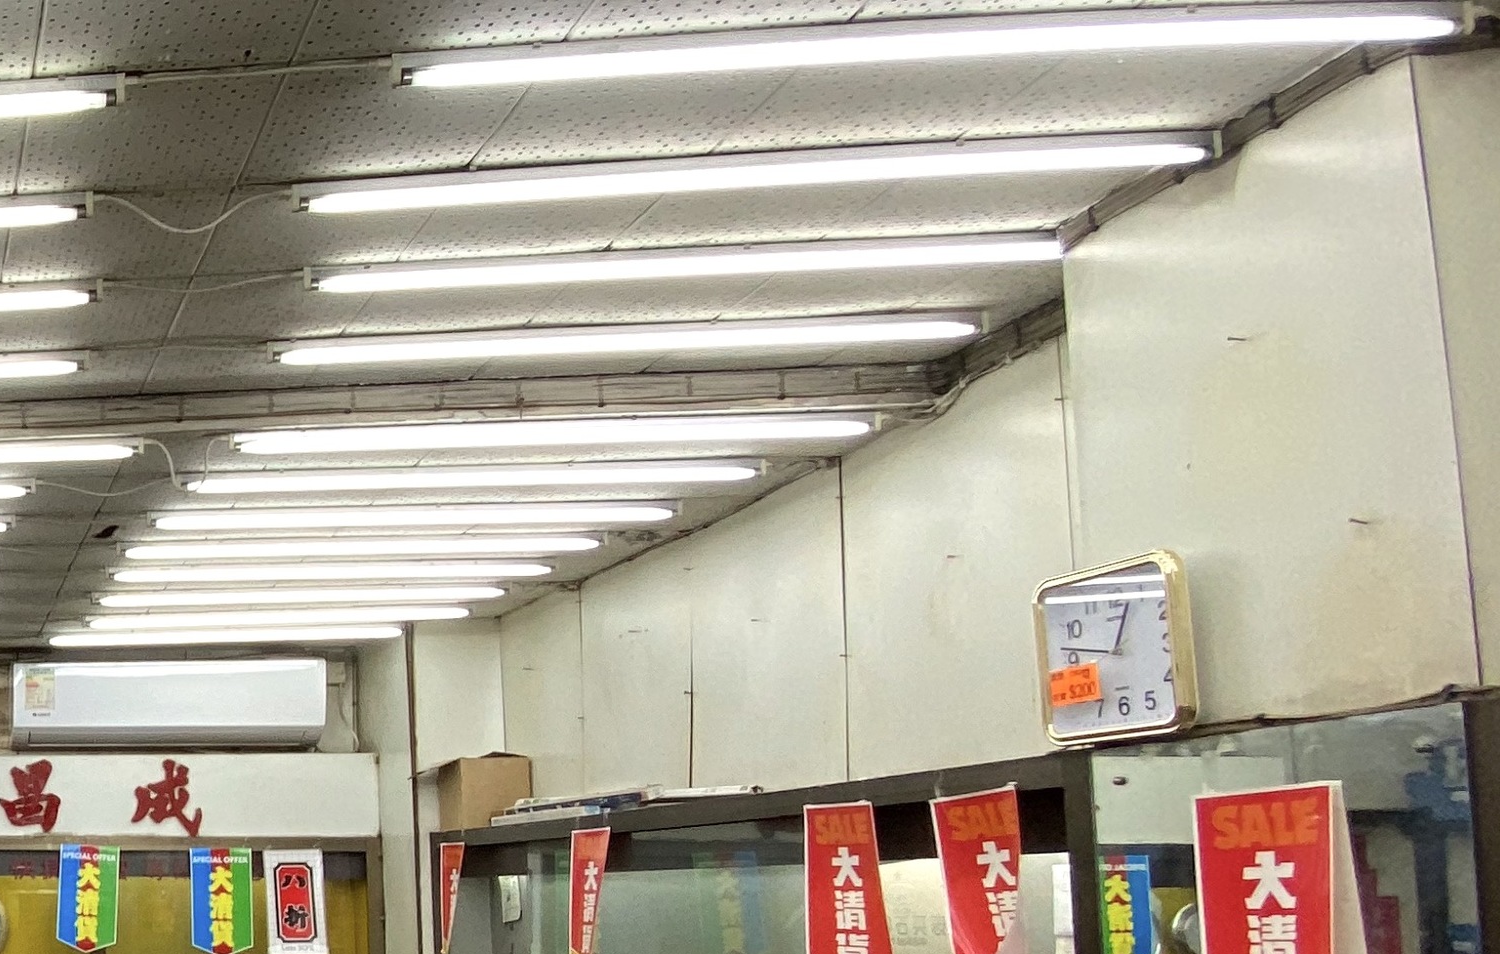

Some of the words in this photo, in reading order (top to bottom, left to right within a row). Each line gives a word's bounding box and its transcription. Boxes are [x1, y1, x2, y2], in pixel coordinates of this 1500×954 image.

[1066, 619, 1082, 640] 10
[1118, 696, 1130, 716] 6
[1144, 690, 1157, 711] 5
[814, 811, 870, 846] SALE
[1211, 799, 1321, 850] SALE
